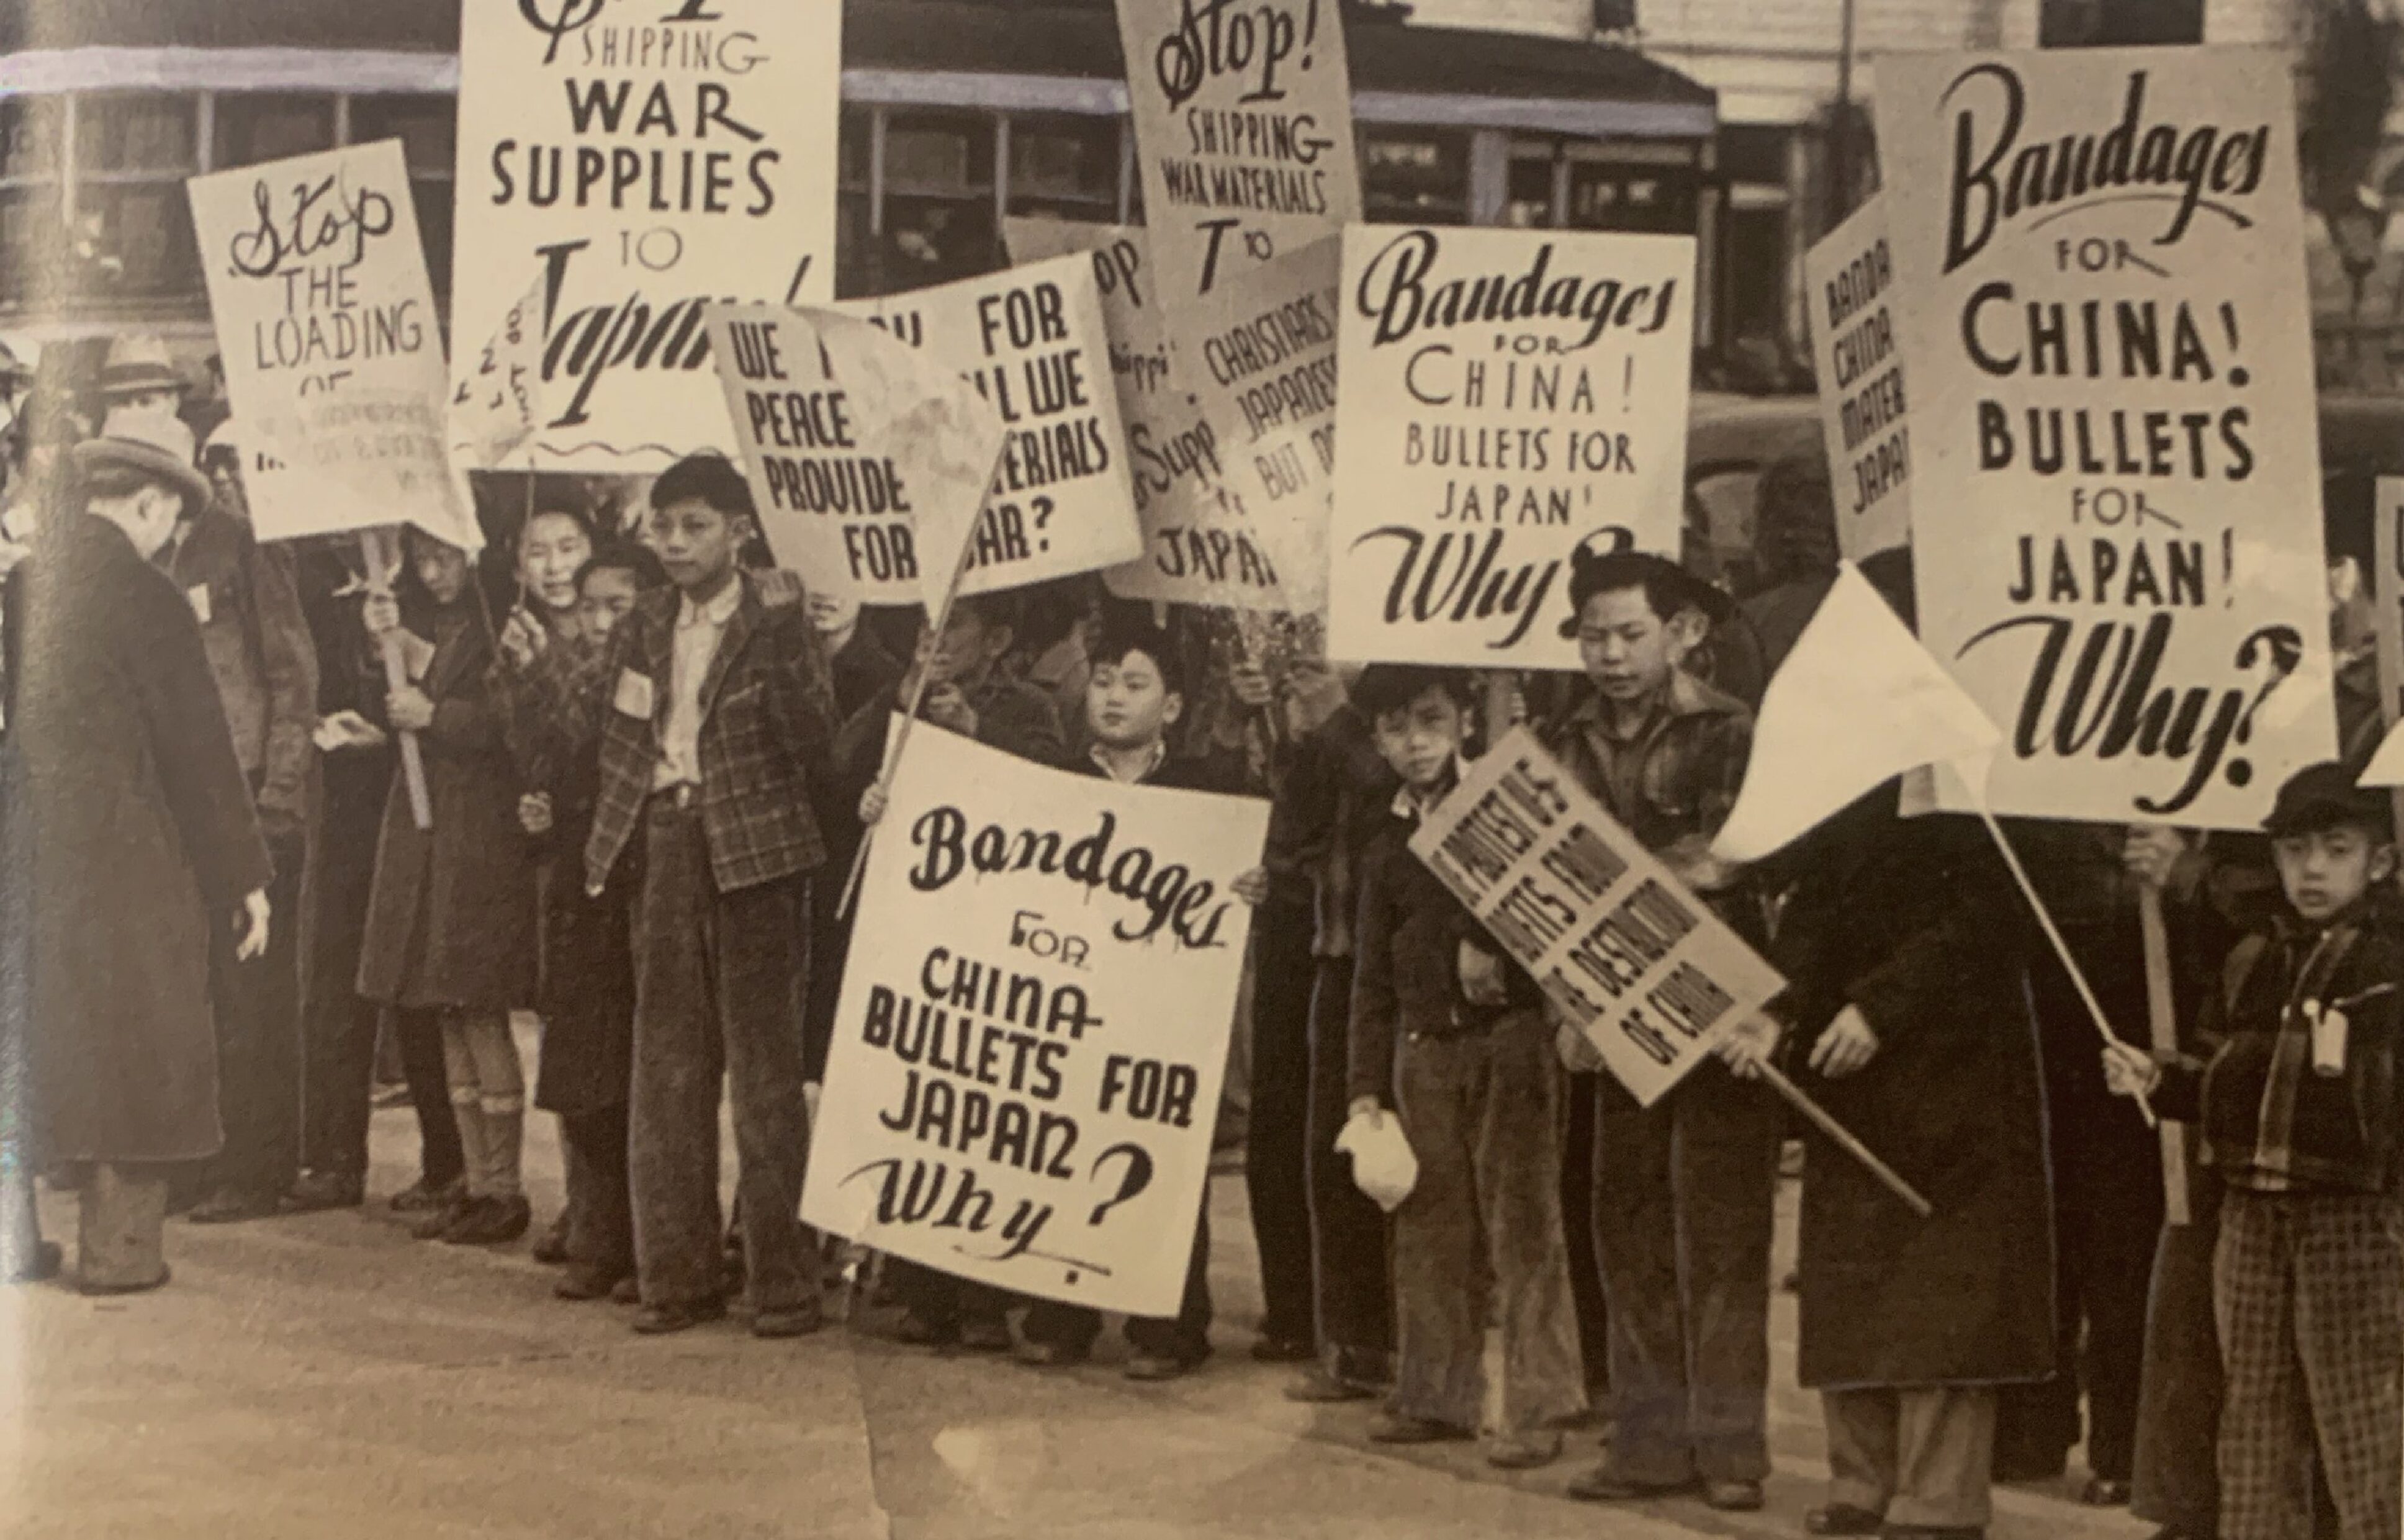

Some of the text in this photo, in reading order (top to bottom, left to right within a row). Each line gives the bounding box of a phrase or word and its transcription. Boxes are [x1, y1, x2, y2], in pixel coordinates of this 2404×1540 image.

[582, 24, 770, 74] SHIPPING
[565, 78, 765, 142] WAR
[1187, 107, 1335, 164] SHIPPING
[492, 140, 781, 217] SUPPLIES
[1211, 165, 1328, 215] MATERIALS
[1935, 63, 2269, 276] Bandages
[228, 179, 393, 277] Stop
[620, 227, 683, 271] TO
[2056, 238, 2171, 278] FOR
[279, 264, 358, 314] THE
[1356, 230, 1678, 349] Bandages
[256, 300, 423, 370] LOADING
[729, 322, 787, 380] WE
[978, 282, 1069, 356] FOR
[1493, 333, 1567, 356] FOR
[1961, 282, 2251, 387] CHINA!
[745, 391, 856, 448] PEACE
[1025, 349, 1088, 417] WE
[1254, 441, 1310, 500] BUT
[1404, 422, 1637, 474] BULLETS FOR
[1978, 399, 2254, 481] BULLETS
[2073, 487, 2182, 529] FOR
[842, 523, 919, 580] FOR
[2008, 527, 2233, 608] JAPAN!
[1955, 613, 2305, 814] Why?
[909, 805, 1233, 950] Bandages
[862, 985, 1198, 1128] BULLETS FOR
[1617, 1006, 1680, 1065] OF
[879, 1070, 1078, 1179] JAPAN
